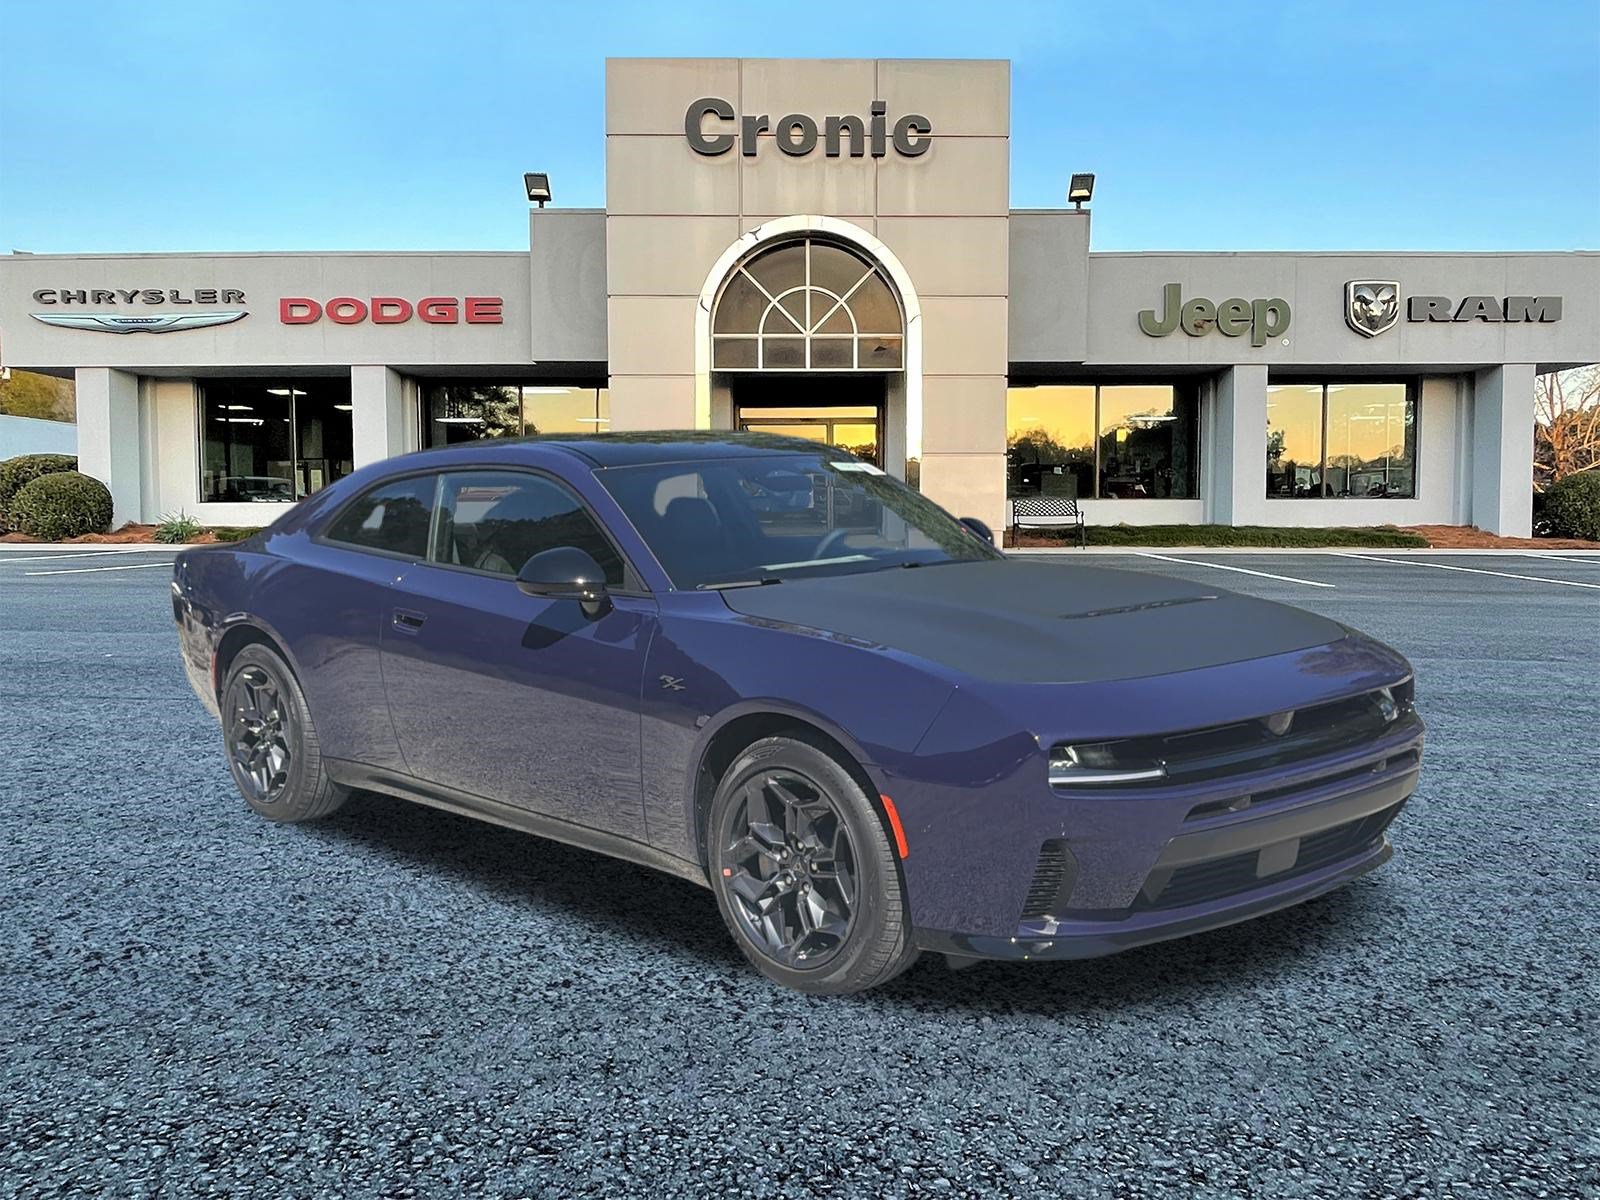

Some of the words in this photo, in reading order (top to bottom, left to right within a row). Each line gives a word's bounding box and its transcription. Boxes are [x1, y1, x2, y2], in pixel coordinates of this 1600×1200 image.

[685, 97, 932, 157] Cronic
[33, 289, 246, 304] CHRYSLER
[1407, 296, 1563, 322] RAM
[280, 297, 503, 324] DODGE
[1138, 283, 1291, 347] Jeep
